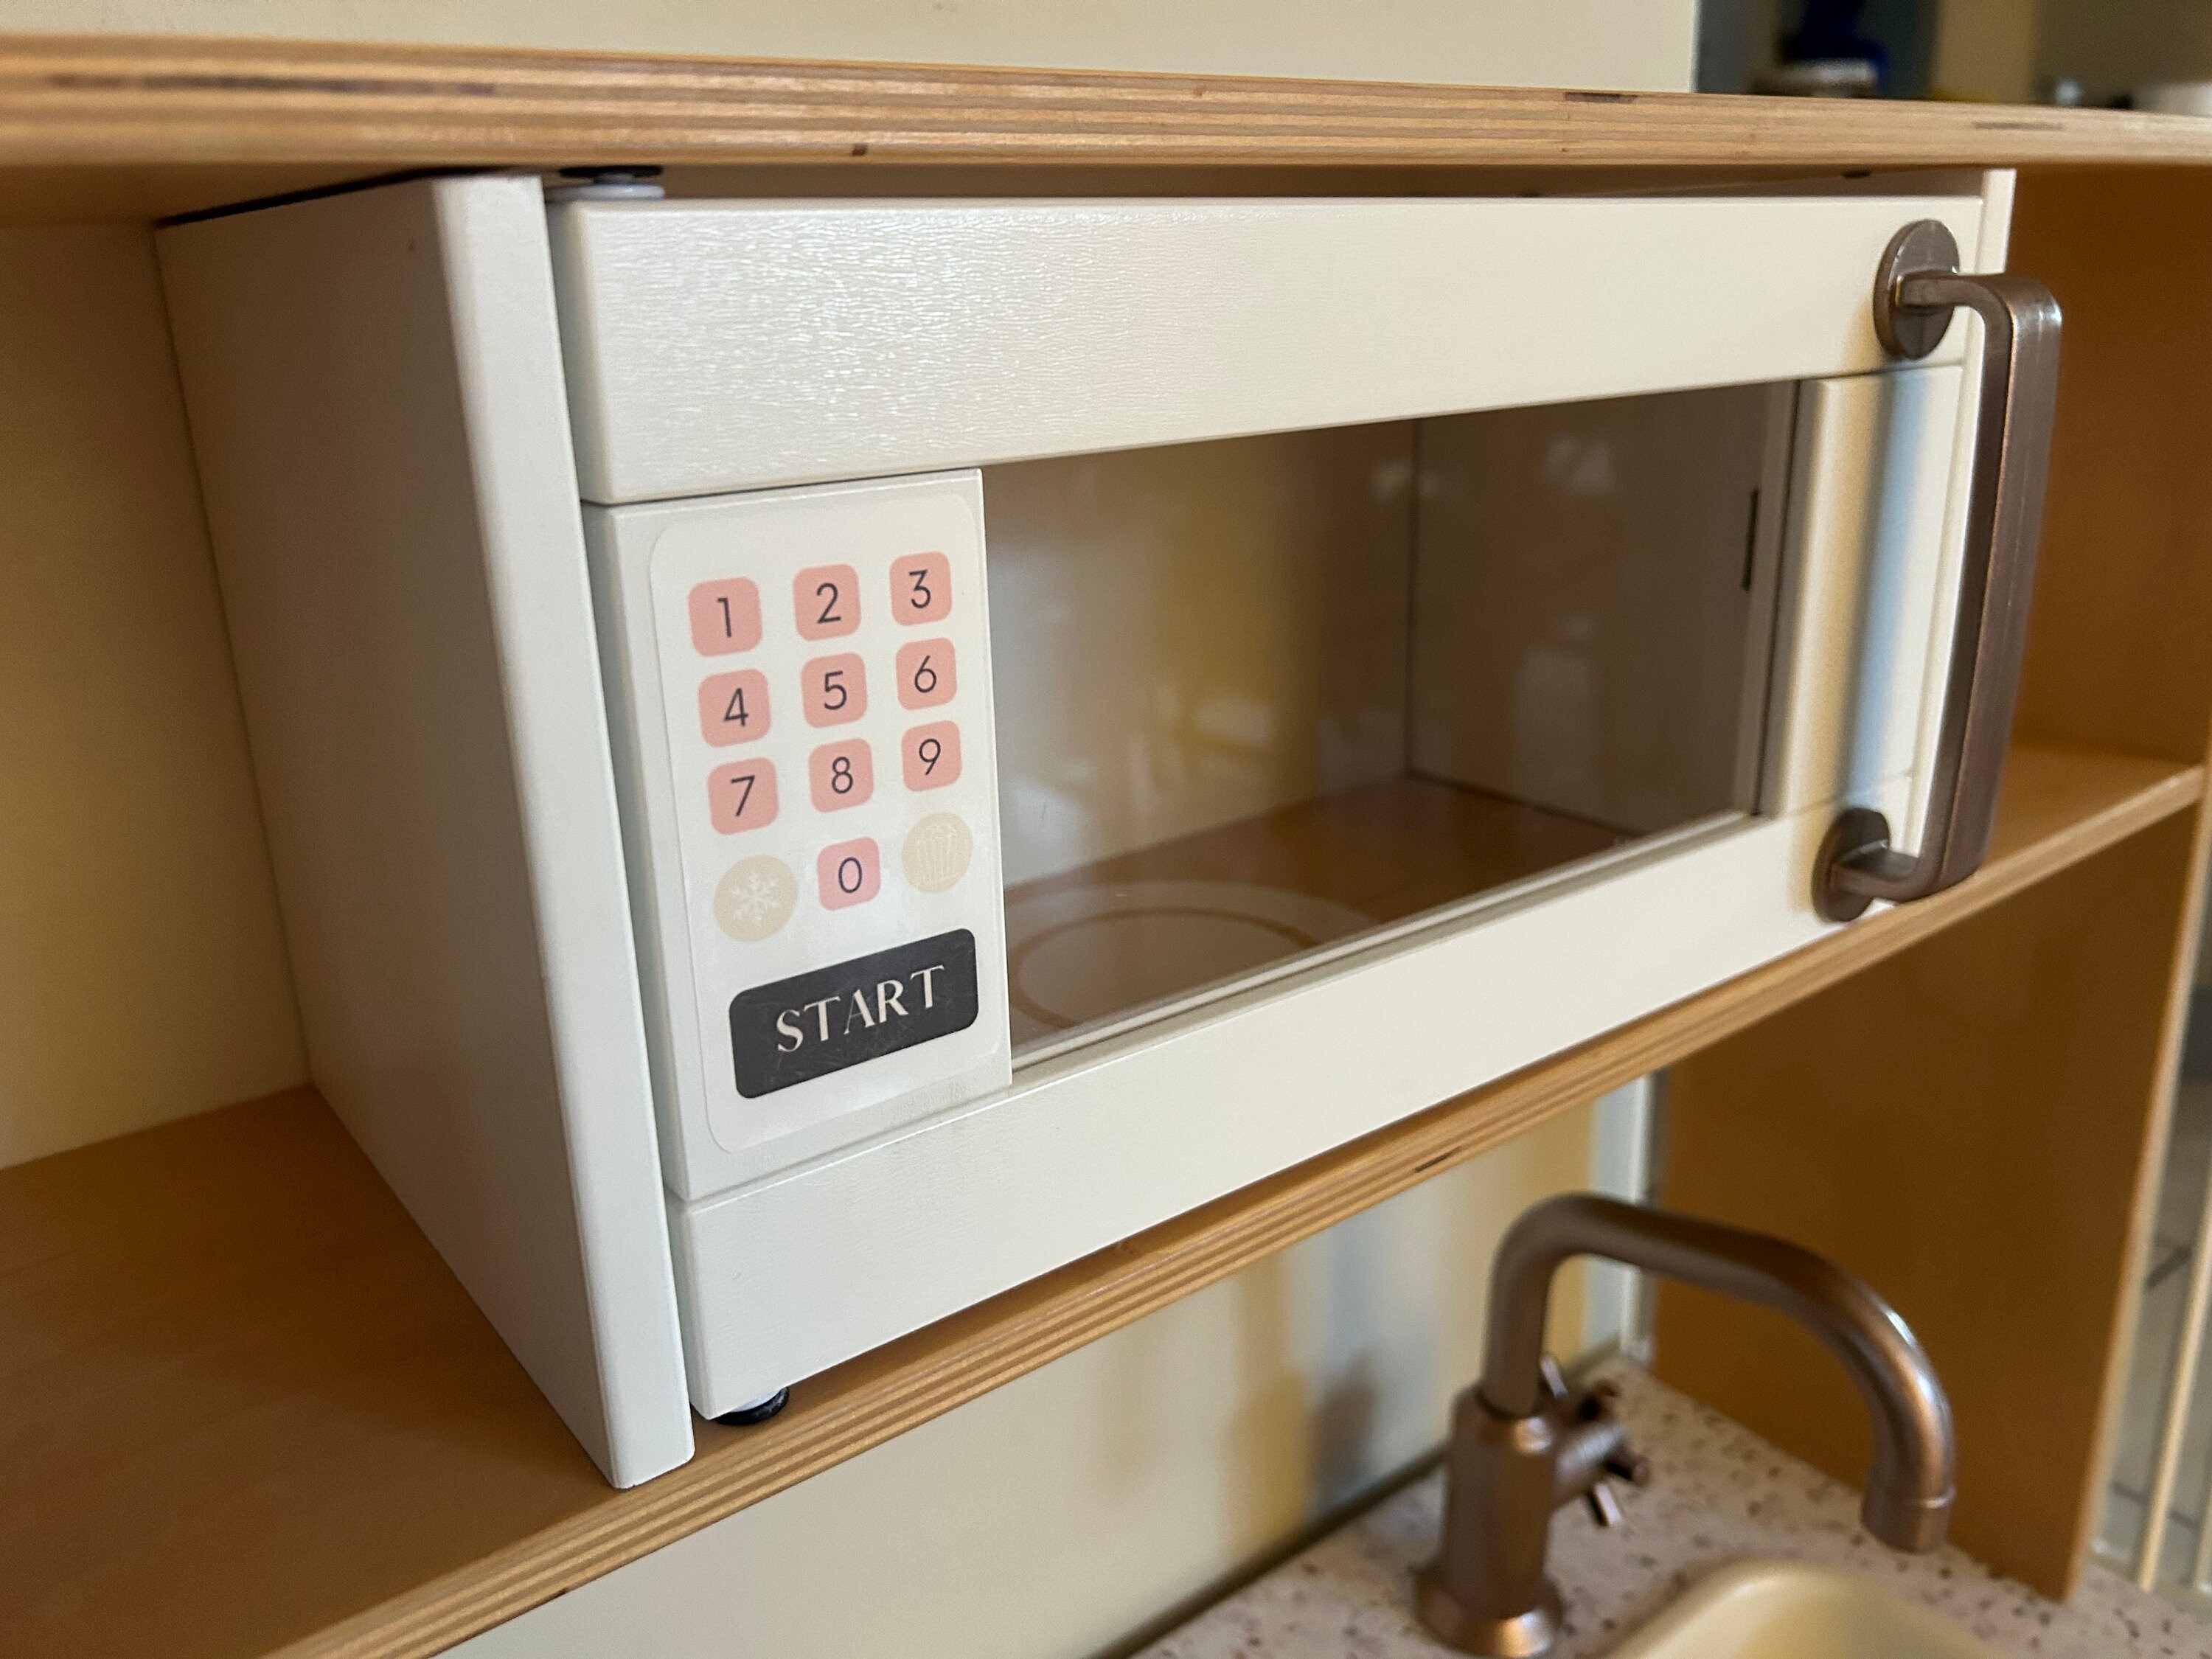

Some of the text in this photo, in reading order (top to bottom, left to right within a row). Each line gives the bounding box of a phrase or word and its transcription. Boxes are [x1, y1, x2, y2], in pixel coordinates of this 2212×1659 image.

[715, 568, 932, 639] 1 2 3
[723, 654, 938, 728] 4 5 6
[730, 737, 942, 818] 7 8 9
[837, 856, 863, 894] 0
[776, 964, 946, 1054] START
